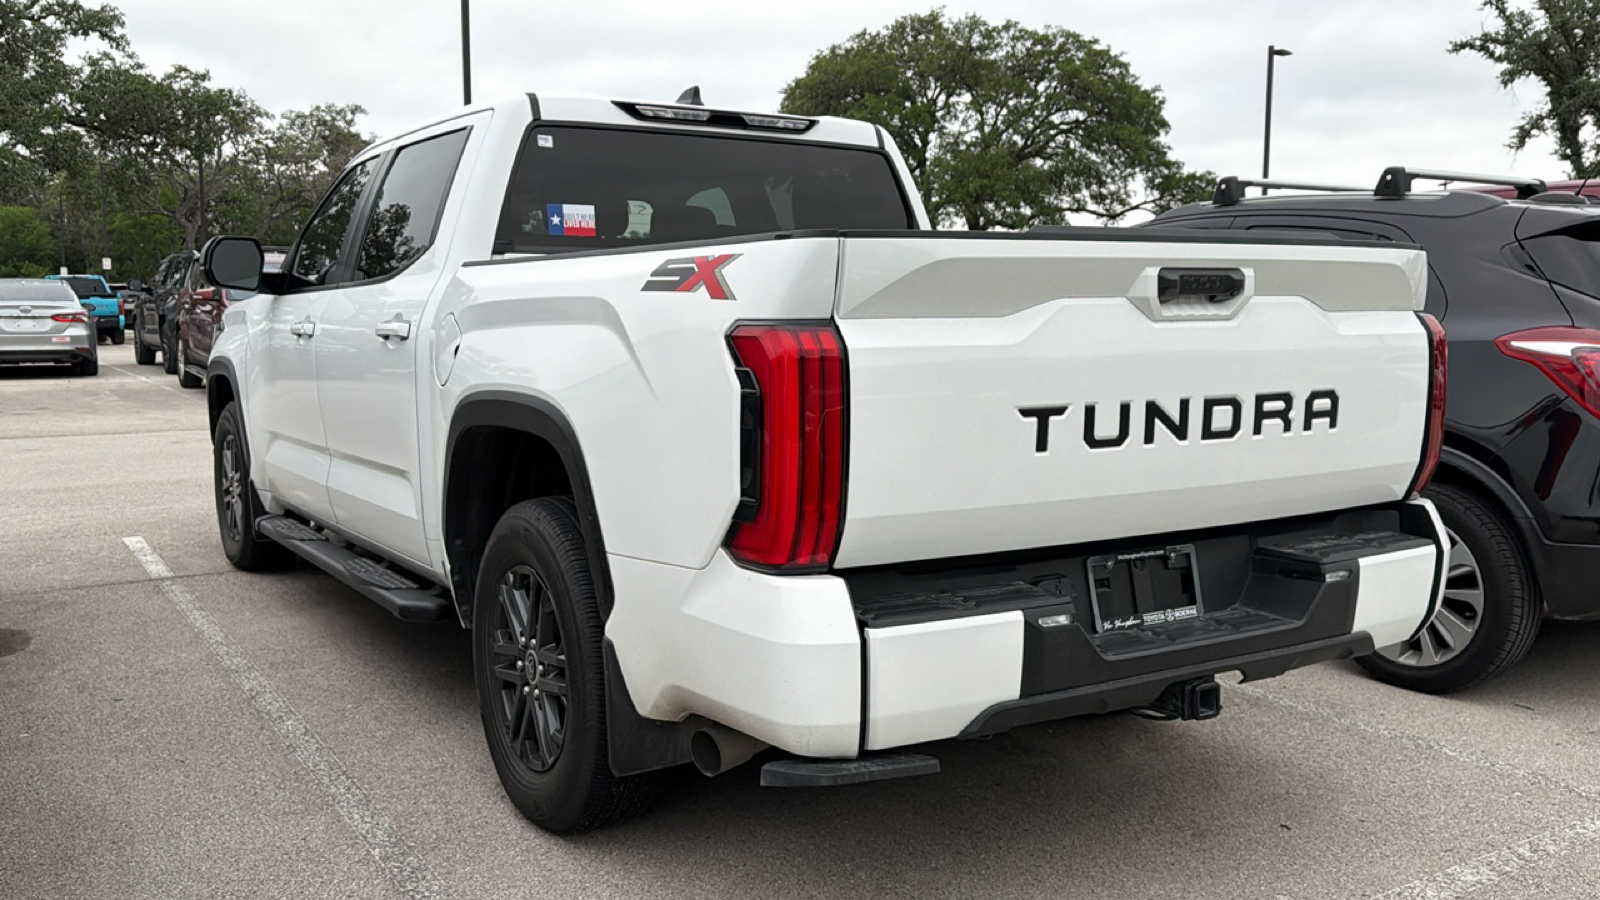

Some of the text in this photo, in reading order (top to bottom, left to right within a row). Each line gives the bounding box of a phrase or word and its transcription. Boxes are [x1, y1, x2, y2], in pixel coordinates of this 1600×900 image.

[640, 253, 743, 300] SX
[1017, 388, 1340, 455] TUNDRA
[1144, 613, 1165, 622] TOYOTA
[1175, 608, 1197, 617] BOERNE
